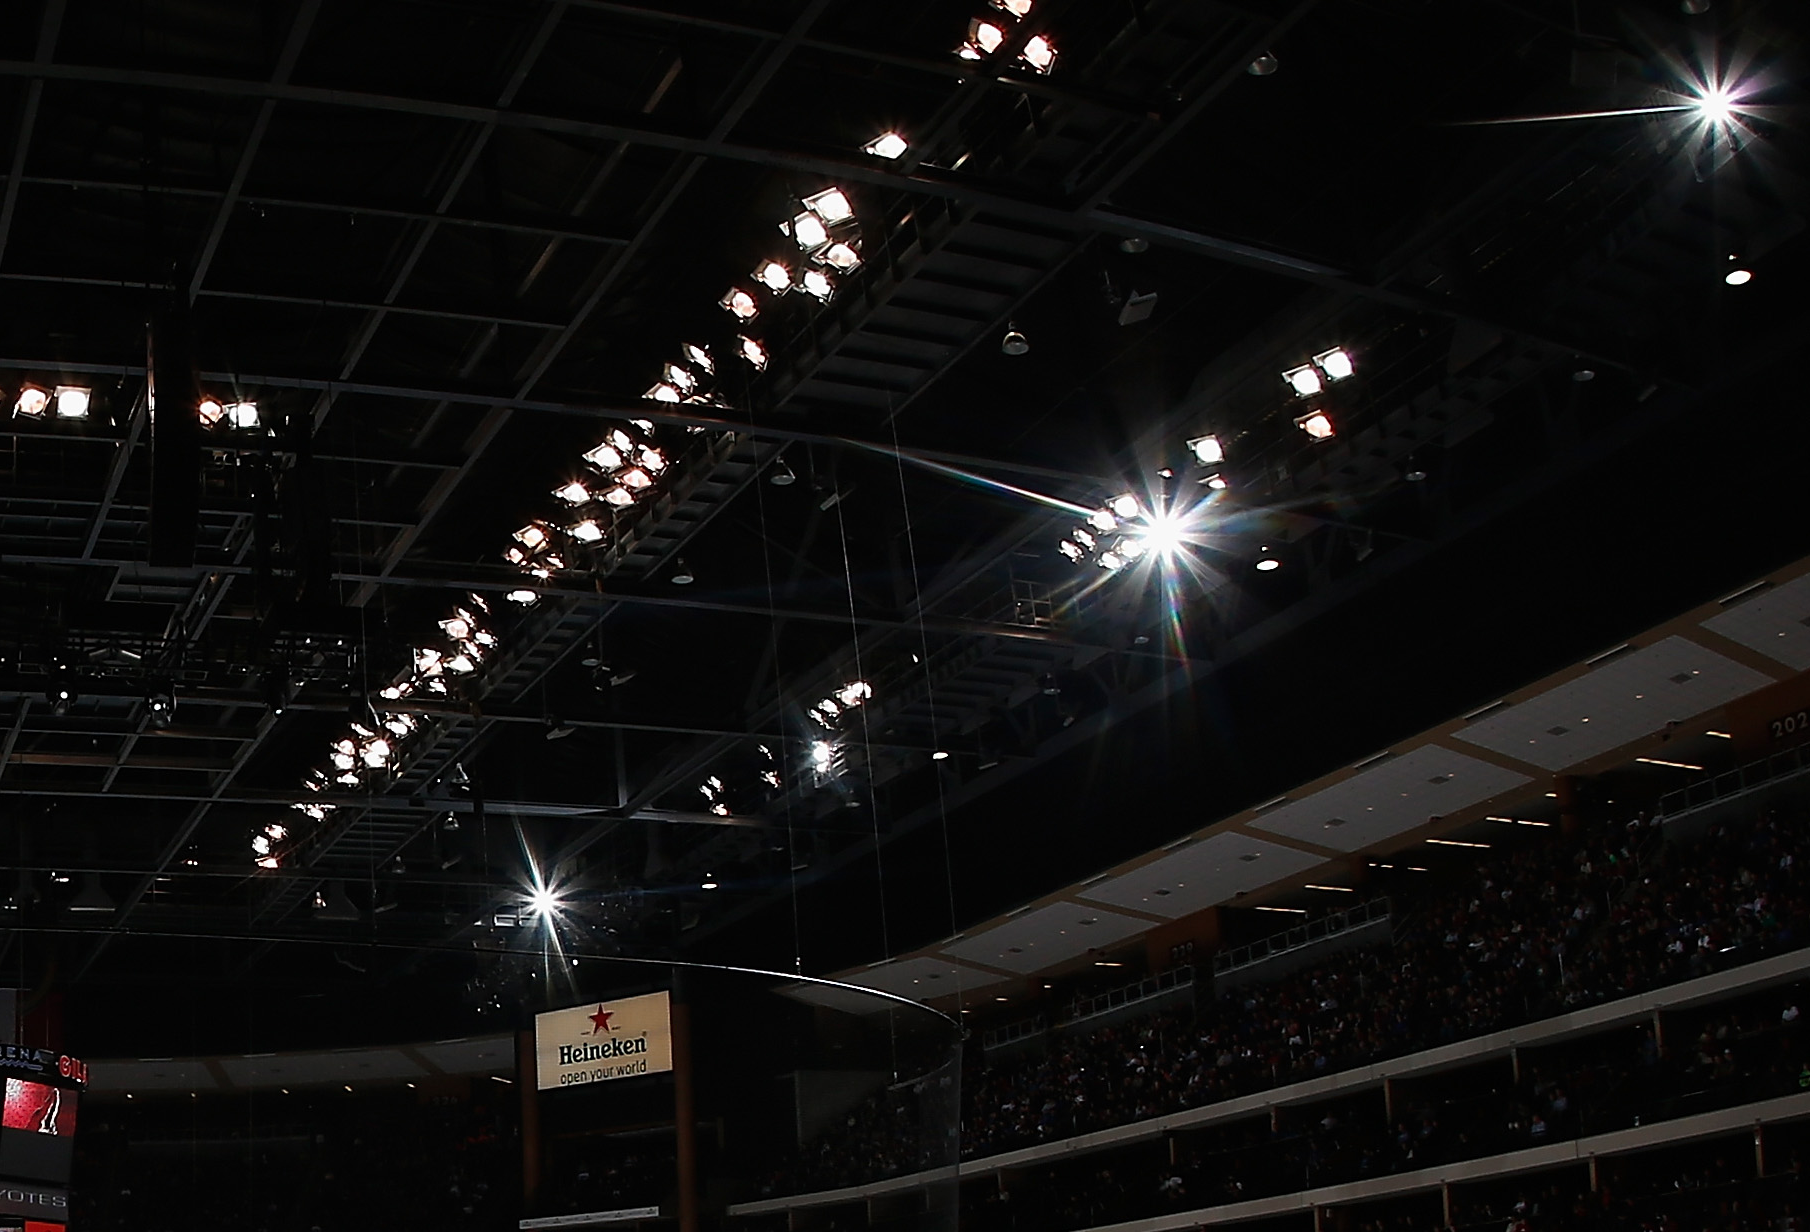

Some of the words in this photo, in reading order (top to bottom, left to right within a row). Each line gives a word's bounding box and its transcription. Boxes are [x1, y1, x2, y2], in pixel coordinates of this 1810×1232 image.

[1772, 712, 1808, 738] 202
[559, 1037, 646, 1065] Heineken
[561, 1072, 587, 1085] open
[590, 1066, 613, 1083] your
[617, 1059, 647, 1075] world
